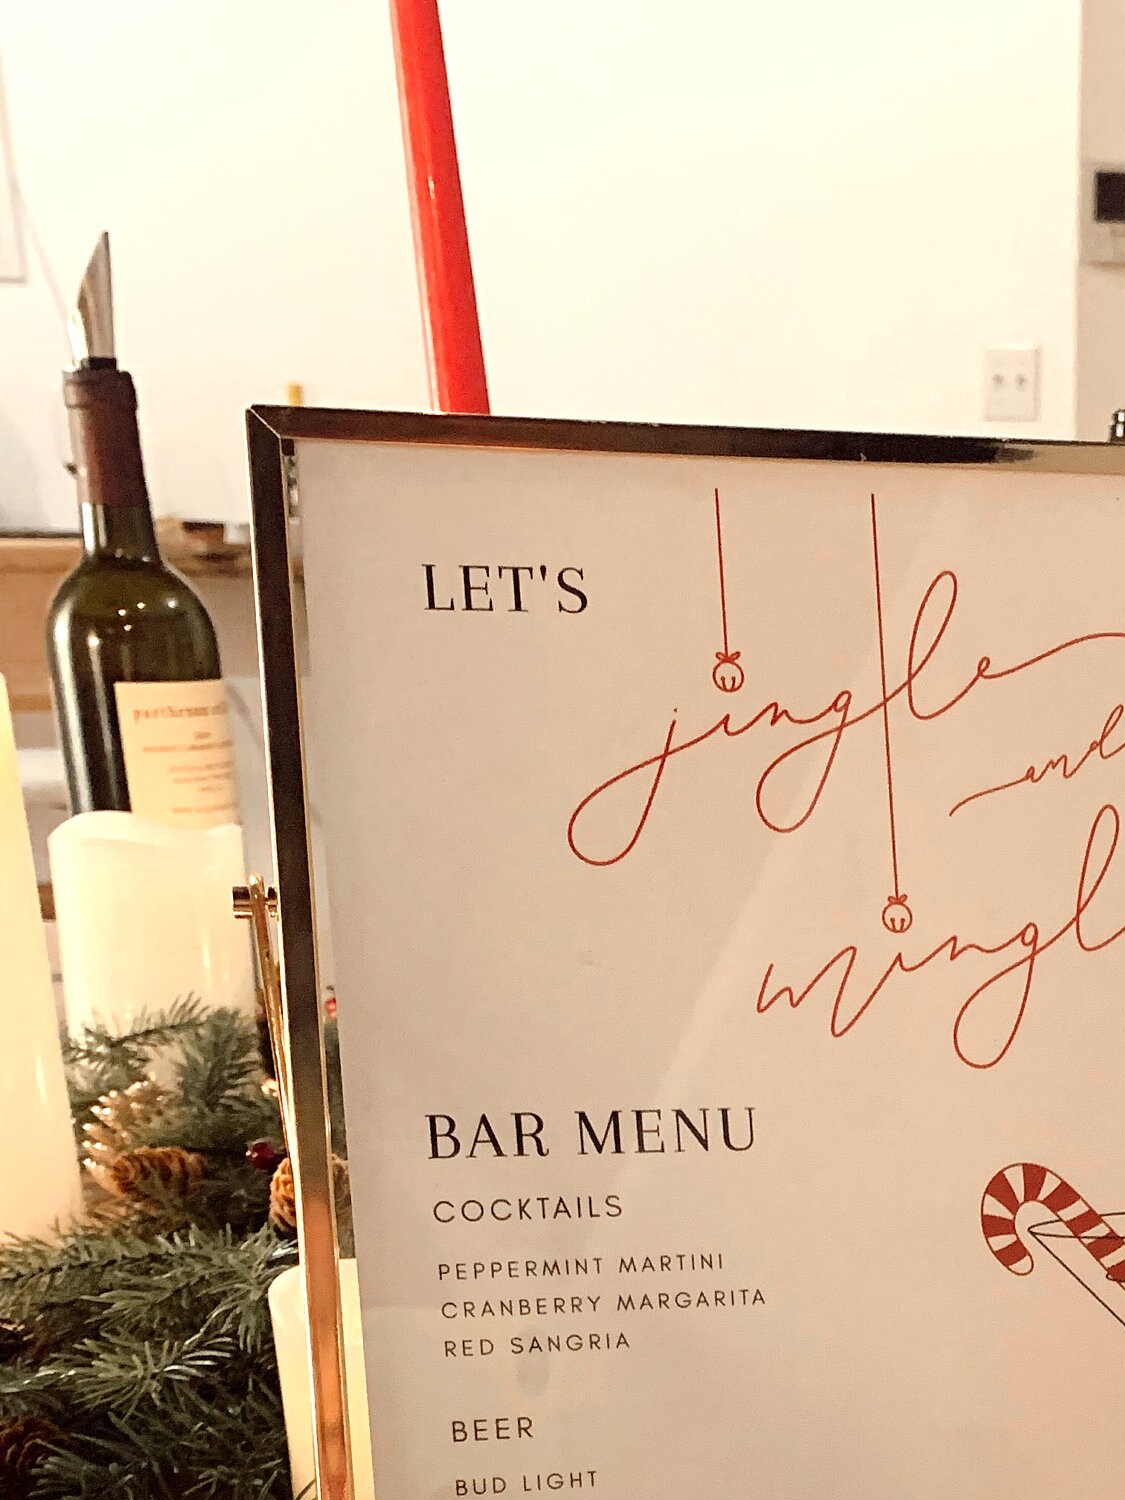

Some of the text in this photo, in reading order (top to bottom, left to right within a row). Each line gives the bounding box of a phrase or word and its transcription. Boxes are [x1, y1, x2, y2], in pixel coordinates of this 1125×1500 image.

[421, 563, 588, 615] LET'S
[423, 1106, 756, 1160] BAR MENU
[432, 1194, 623, 1224] COCKTAILS
[437, 1252, 723, 1281] PEPPERMINT MARTINI
[440, 1288, 766, 1320] CRANBERRY MARGARITA
[443, 1331, 630, 1358] RED SANGRIA
[451, 1416, 534, 1443] BEER
[455, 1470, 598, 1497] BUD LIGHT
